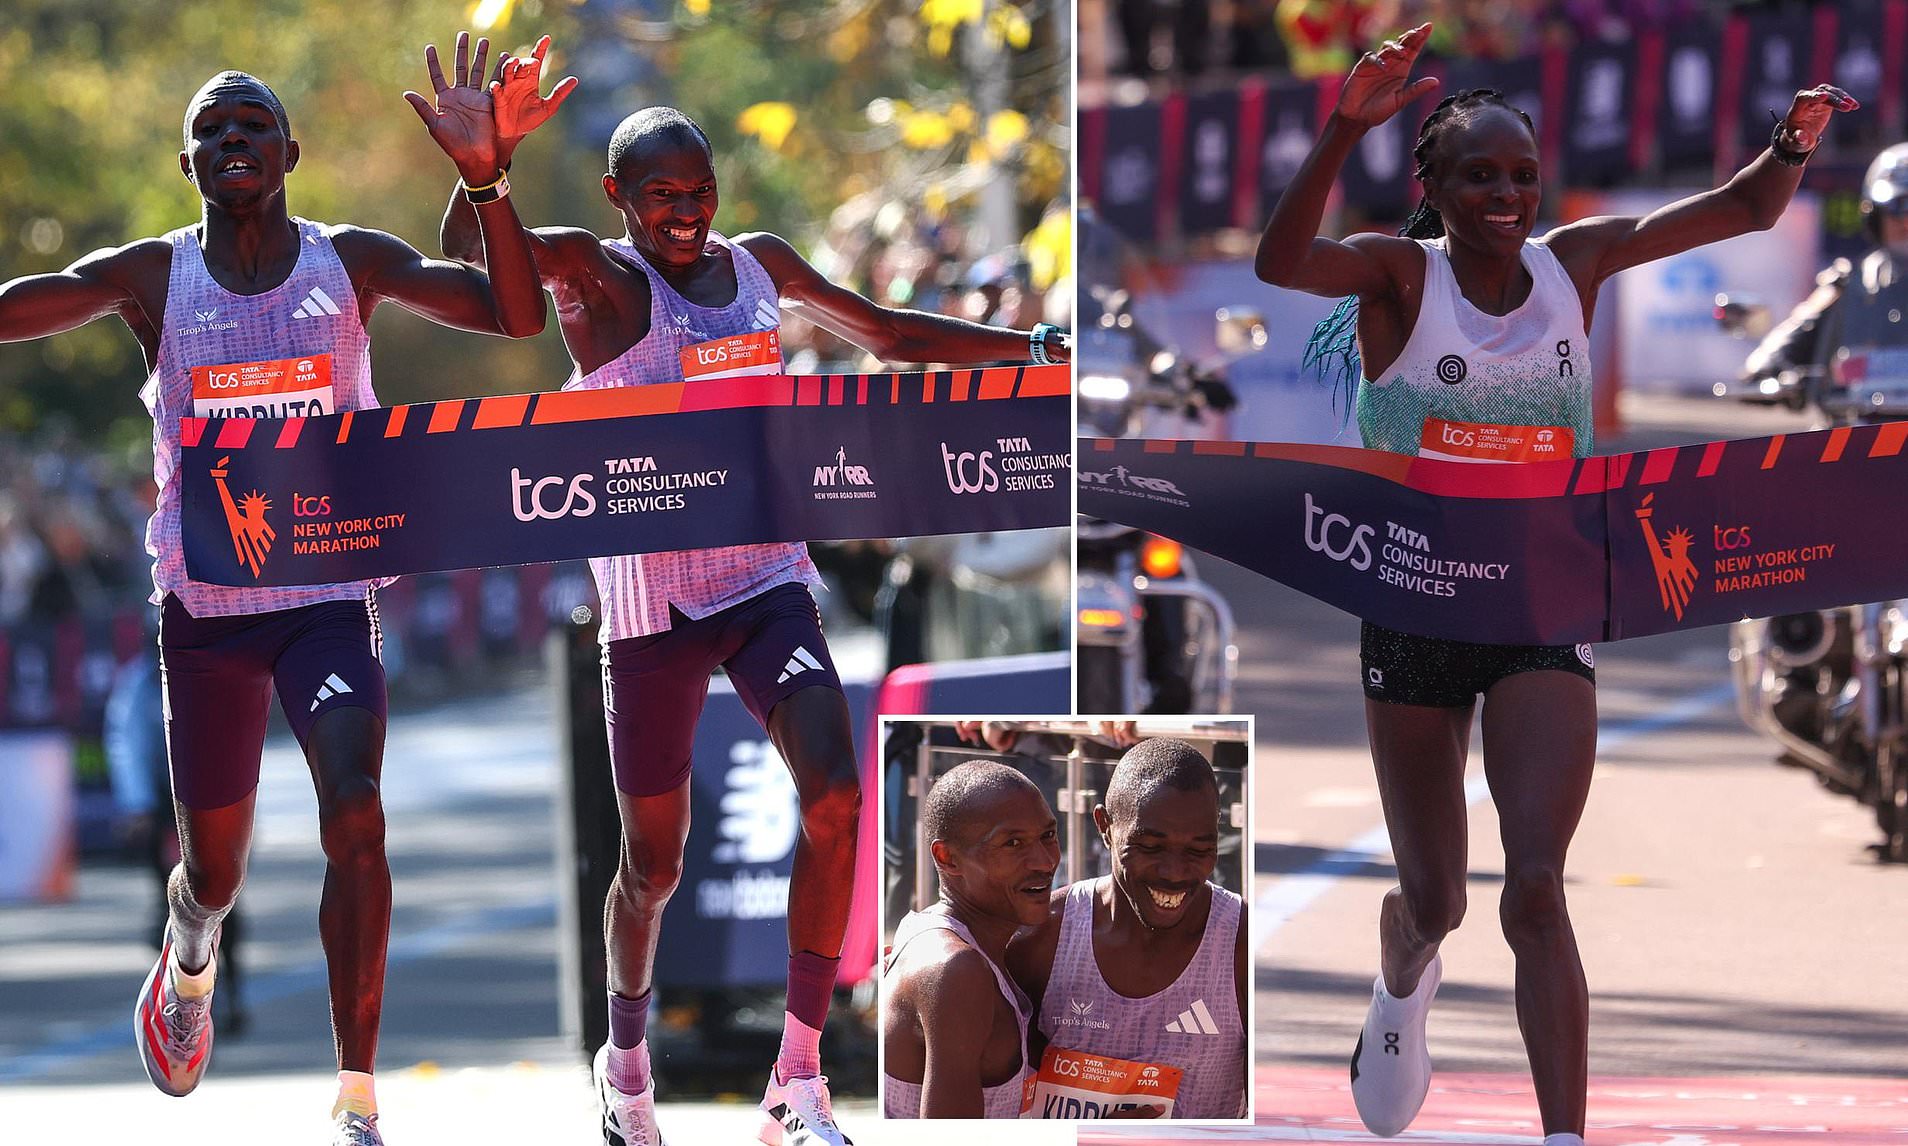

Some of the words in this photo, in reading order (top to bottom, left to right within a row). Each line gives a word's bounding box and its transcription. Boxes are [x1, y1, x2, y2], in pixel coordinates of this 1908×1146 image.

[176, 325, 206, 337] Tirop's
[207, 320, 238, 332] Angels
[697, 346, 728, 365] tcs
[208, 370, 239, 389] tcs
[242, 371, 284, 380] CONSULTANCY
[242, 379, 270, 387] SERVICES
[296, 373, 317, 382] TATA
[1441, 423, 1475, 447] tcs
[1478, 435, 1524, 445] CONSULTANCY
[997, 437, 1032, 453] TATA
[1476, 441, 1507, 451] SERVICES
[1533, 444, 1554, 452] TATA
[604, 456, 657, 475] TATA
[941, 442, 999, 494] tcs
[606, 470, 728, 495] CONSULTANCY
[1005, 474, 1055, 492] SERVICES
[511, 467, 597, 522] tcs
[607, 493, 686, 515] SERVICES
[826, 492, 840, 500] YORK
[840, 491, 853, 499] ROAD
[293, 492, 332, 517] tcs
[293, 522, 332, 538] NEW
[334, 518, 373, 536] YORK
[374, 513, 406, 531] CITY
[1304, 492, 1376, 572] tcs
[293, 533, 380, 555] MARATHON
[1386, 521, 1431, 553] TATA
[1713, 524, 1751, 550] tcs
[1382, 543, 1510, 580] CONSULTANCY
[1715, 555, 1751, 574] NEW
[1754, 549, 1798, 568] YORK
[1799, 543, 1836, 562] CITY
[1378, 564, 1457, 597] SERVICES
[1715, 567, 1806, 593] MARATHON
[1052, 1016, 1081, 1027] Tiop's
[1081, 1017, 1110, 1030] Angels
[1053, 1053, 1080, 1077] tcs
[1082, 1066, 1128, 1079] CONSULTANCY
[1084, 1058, 1103, 1068] TATA
[1082, 1073, 1110, 1084] SERVICES
[1137, 1079, 1159, 1087] TATA
